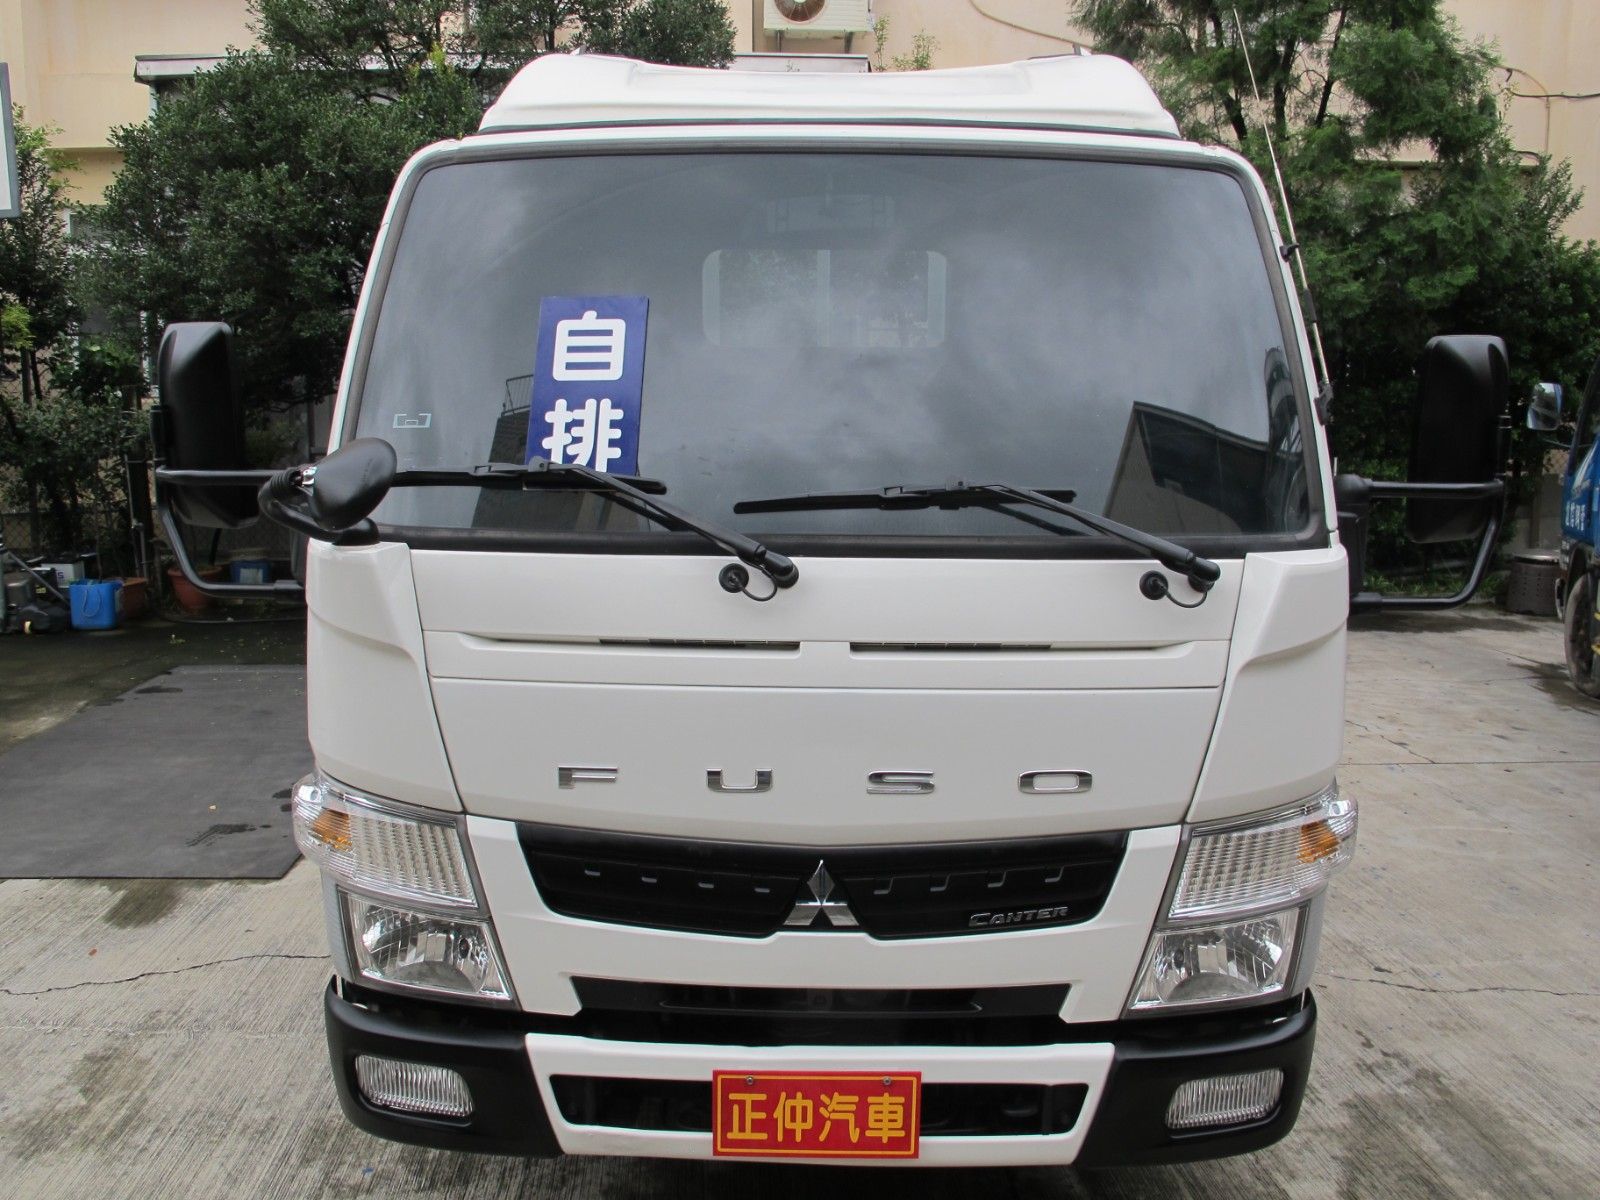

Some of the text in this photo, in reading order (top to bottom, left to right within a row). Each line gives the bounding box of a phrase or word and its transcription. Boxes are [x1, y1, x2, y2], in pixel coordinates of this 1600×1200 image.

[542, 310, 626, 472] 自排
[558, 766, 1093, 794] FUSO
[726, 1091, 906, 1143] 正仲汽車
